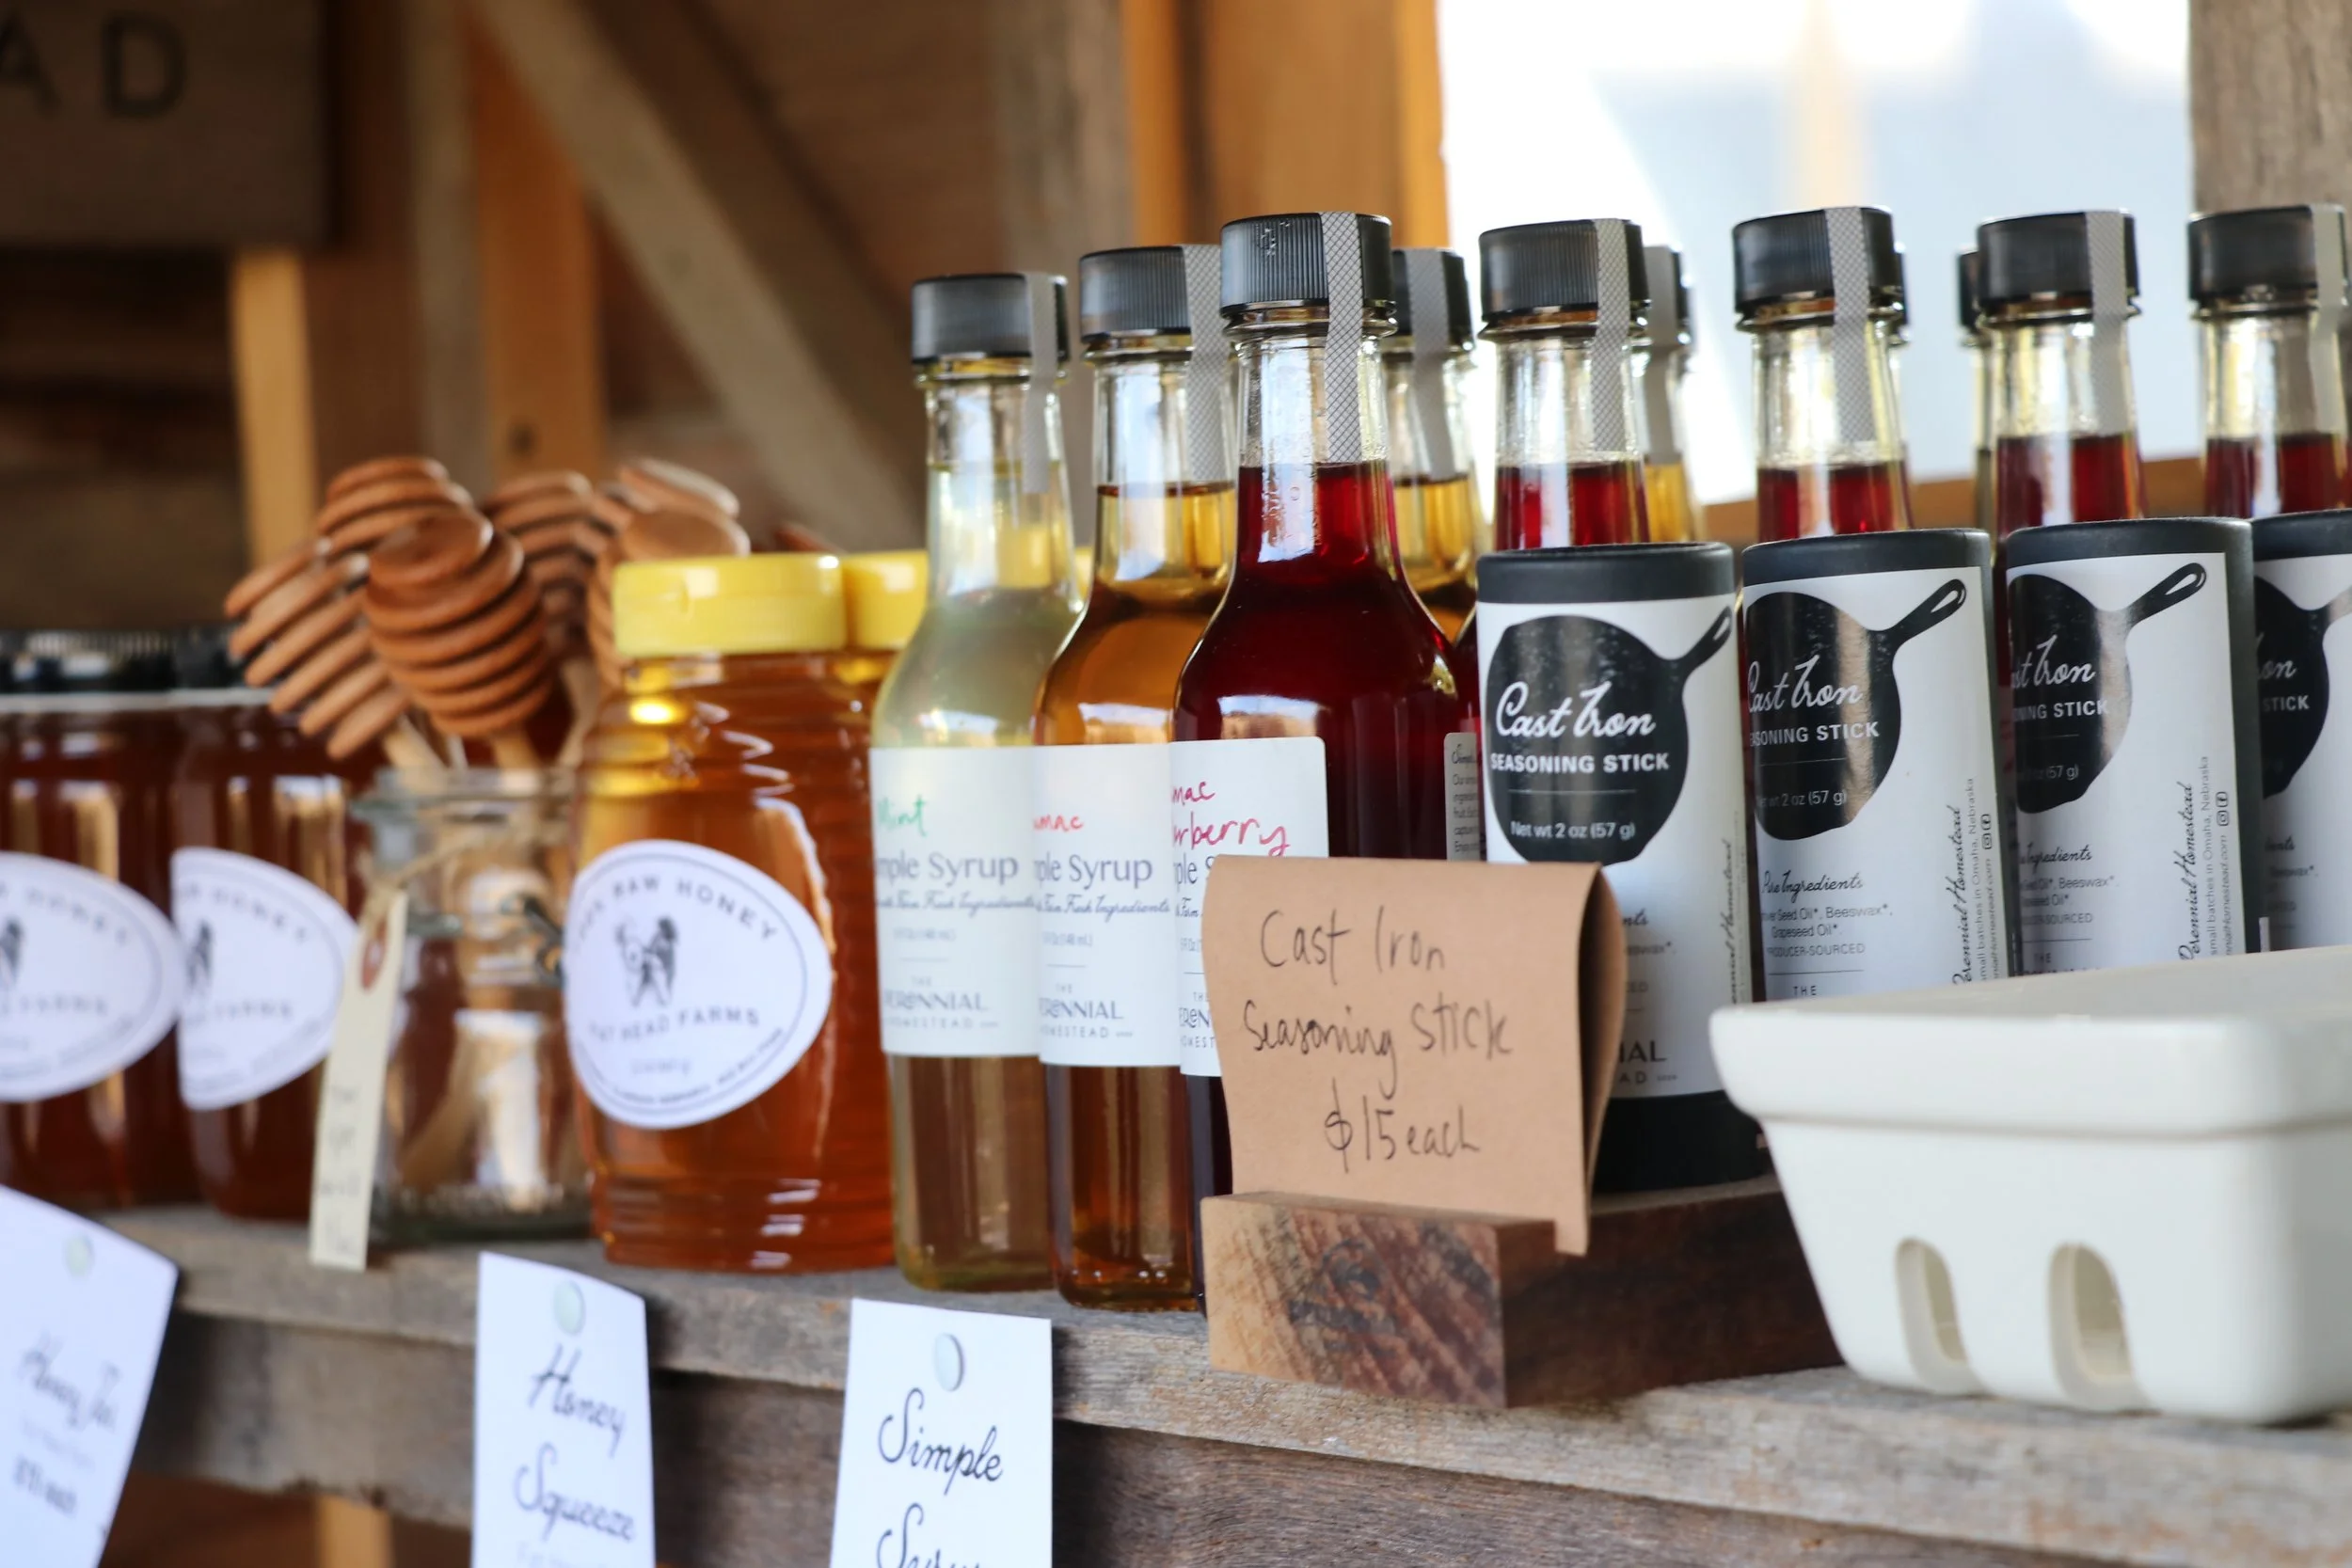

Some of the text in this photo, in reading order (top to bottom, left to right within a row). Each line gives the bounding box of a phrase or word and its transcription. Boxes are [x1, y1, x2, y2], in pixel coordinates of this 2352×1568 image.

[1748, 654, 1864, 713] Cast Iron
[2033, 634, 2096, 687] Iron
[1496, 680, 1656, 738] Cast Iron
[2053, 699, 2110, 719] STICK
[2262, 694, 2311, 713] STICK
[1816, 721, 1880, 741] STICK
[1490, 753, 1595, 774] SEASONING
[1603, 752, 1670, 773] STICK
[2198, 756, 2211, 812] Nebraska
[1807, 790, 1830, 806] (57
[1833, 790, 1849, 807] g)
[1965, 777, 1978, 835] Nebraska
[1510, 820, 1532, 837] Net
[1554, 823, 1565, 839] 2
[1568, 826, 1589, 838] oz
[1590, 822, 1615, 839] (57
[1618, 821, 1637, 841] g)
[1945, 803, 1967, 904] Homestead
[928, 851, 1020, 889] Syrup
[1068, 853, 1154, 890] Syrup
[1781, 869, 1865, 904] Ingredients
[2172, 780, 2201, 961] Perennial Homestead
[2203, 863, 2214, 875] in
[675, 877, 780, 942] HONEY
[1972, 889, 1981, 900] in
[2204, 878, 2217, 924] batches
[1260, 906, 1446, 985] Cast Iron
[1974, 903, 1986, 950] batches
[1792, 985, 1818, 997] THE
[676, 1004, 761, 1029] FARMS
[1243, 998, 1398, 1101] Seasoning
[528, 1342, 626, 1459] Honey
[878, 1386, 1004, 1497] Simple
[511, 1440, 635, 1543] Squeeze
